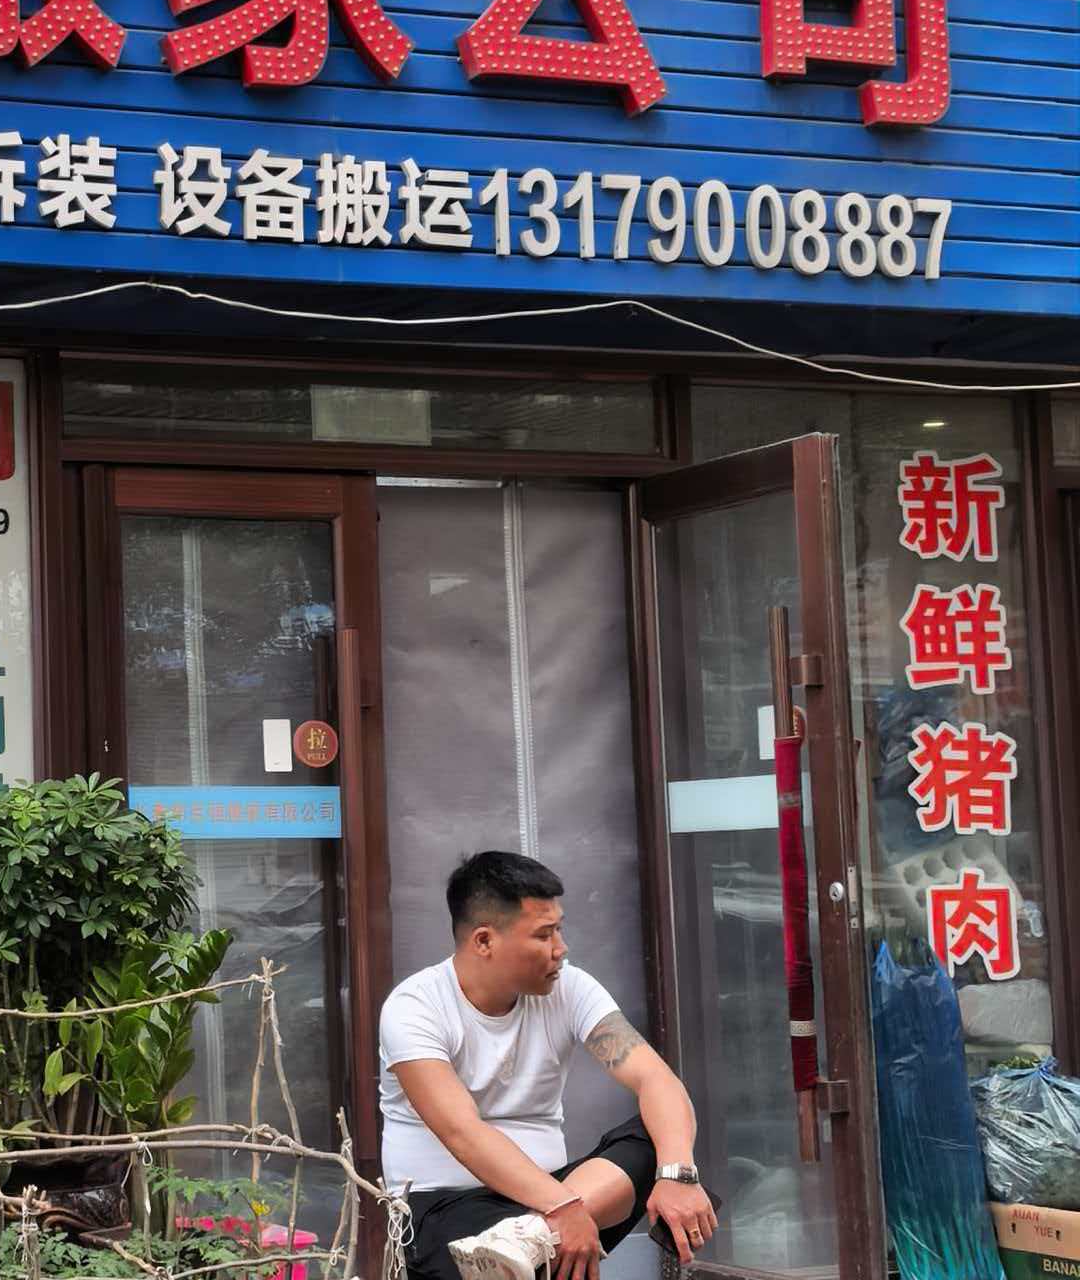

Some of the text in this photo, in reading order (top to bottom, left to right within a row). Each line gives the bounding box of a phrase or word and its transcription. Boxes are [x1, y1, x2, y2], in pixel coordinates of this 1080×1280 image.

[899, 451, 1020, 980] 新鲜猪肉
[1034, 1225, 1054, 1238] YUE
